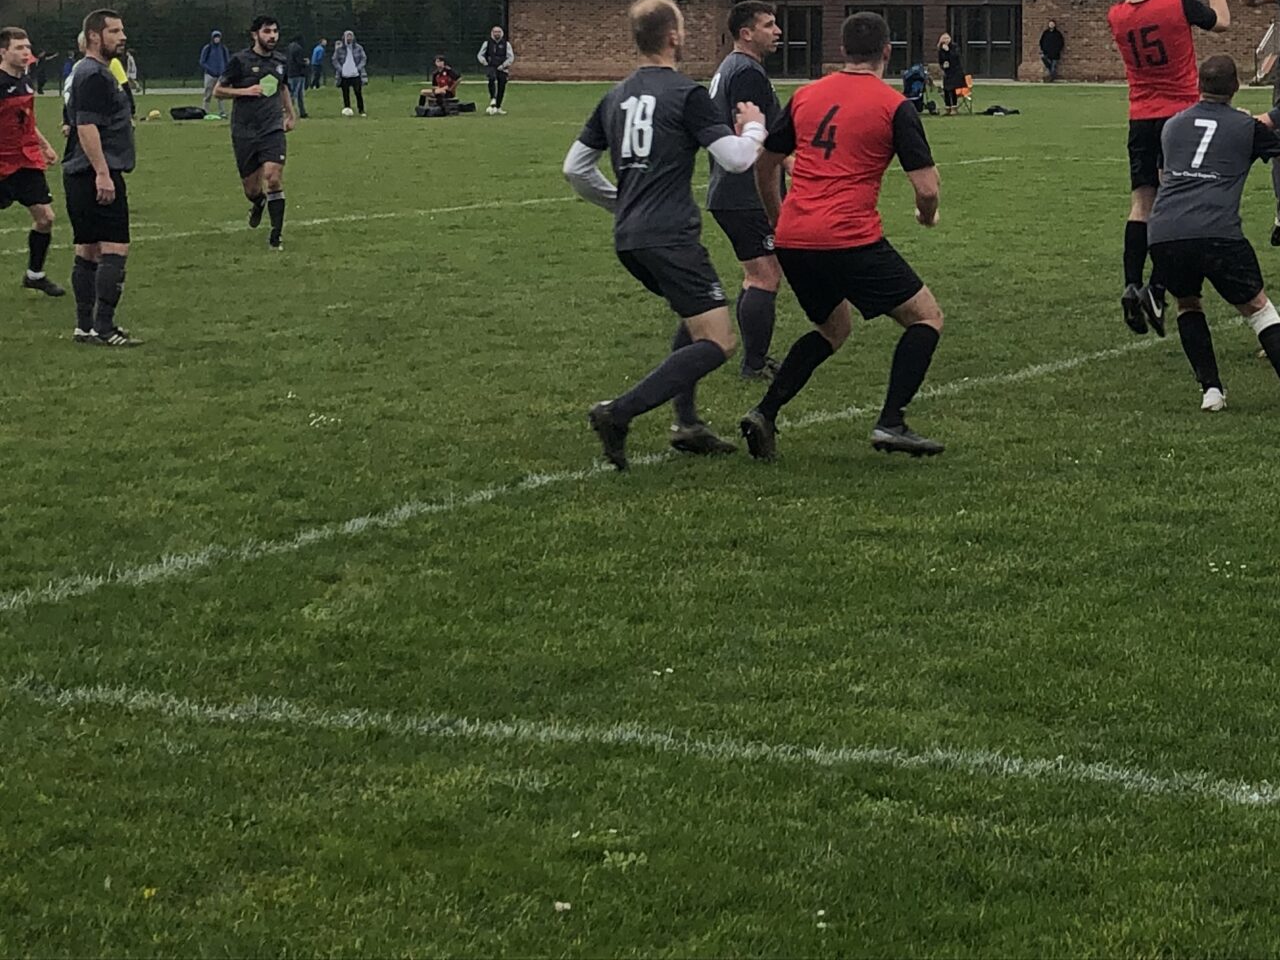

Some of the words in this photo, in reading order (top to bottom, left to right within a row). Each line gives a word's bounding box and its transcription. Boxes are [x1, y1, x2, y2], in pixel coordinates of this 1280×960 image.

[1127, 24, 1168, 69] 15
[620, 94, 657, 158] 18
[811, 104, 840, 160] 4
[1191, 119, 1218, 169] 7
